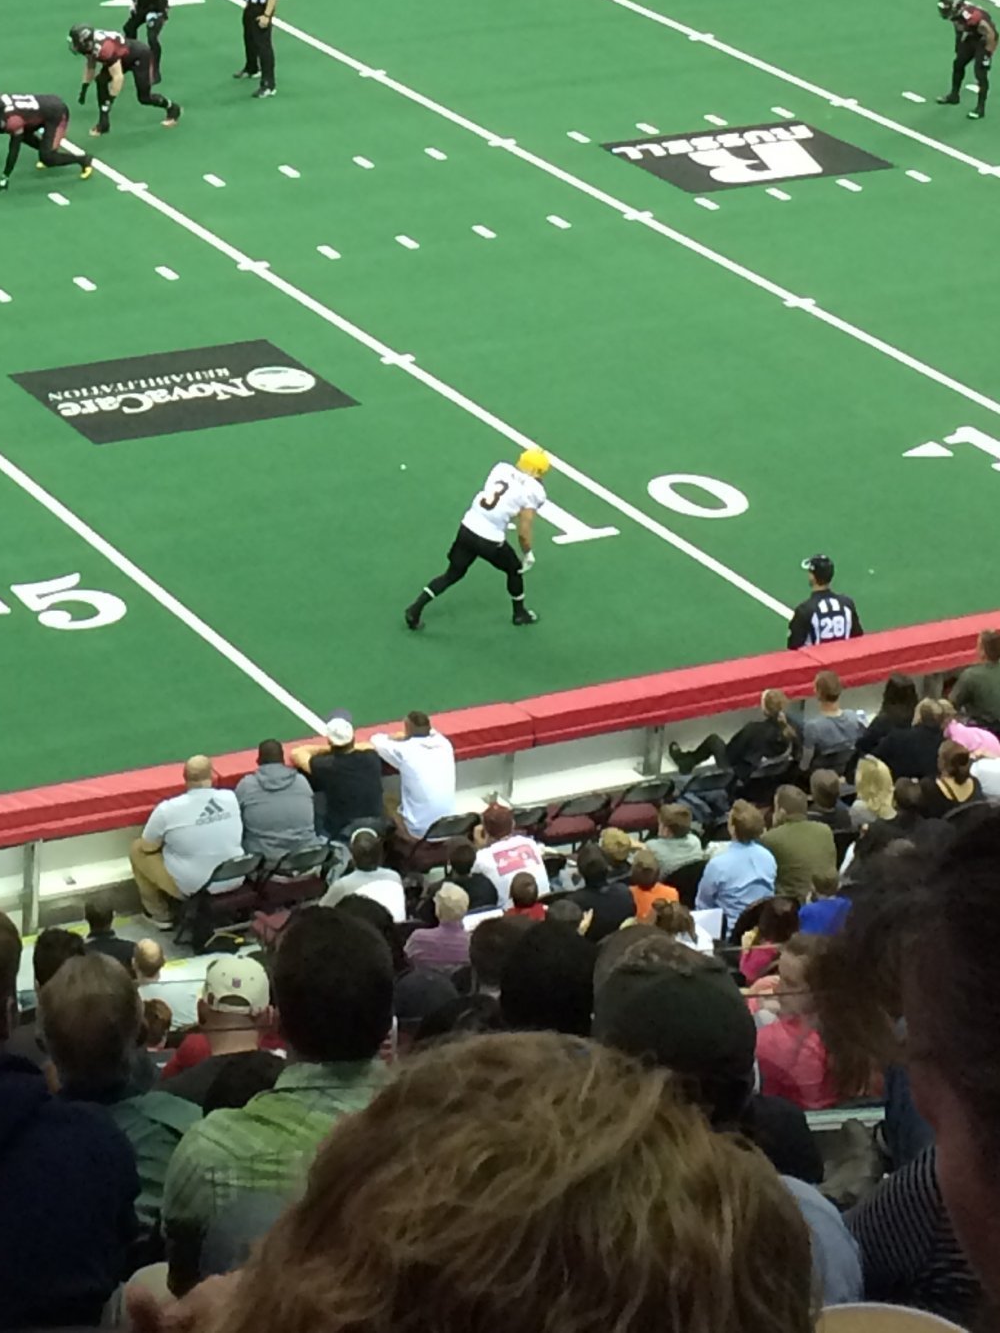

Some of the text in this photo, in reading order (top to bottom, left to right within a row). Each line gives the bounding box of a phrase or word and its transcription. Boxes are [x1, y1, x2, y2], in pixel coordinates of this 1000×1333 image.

[48, 368, 230, 402] REHABILITATION
[57, 378, 255, 416] NovaCare
[479, 480, 510, 510] 3
[10, 572, 127, 630] 5
